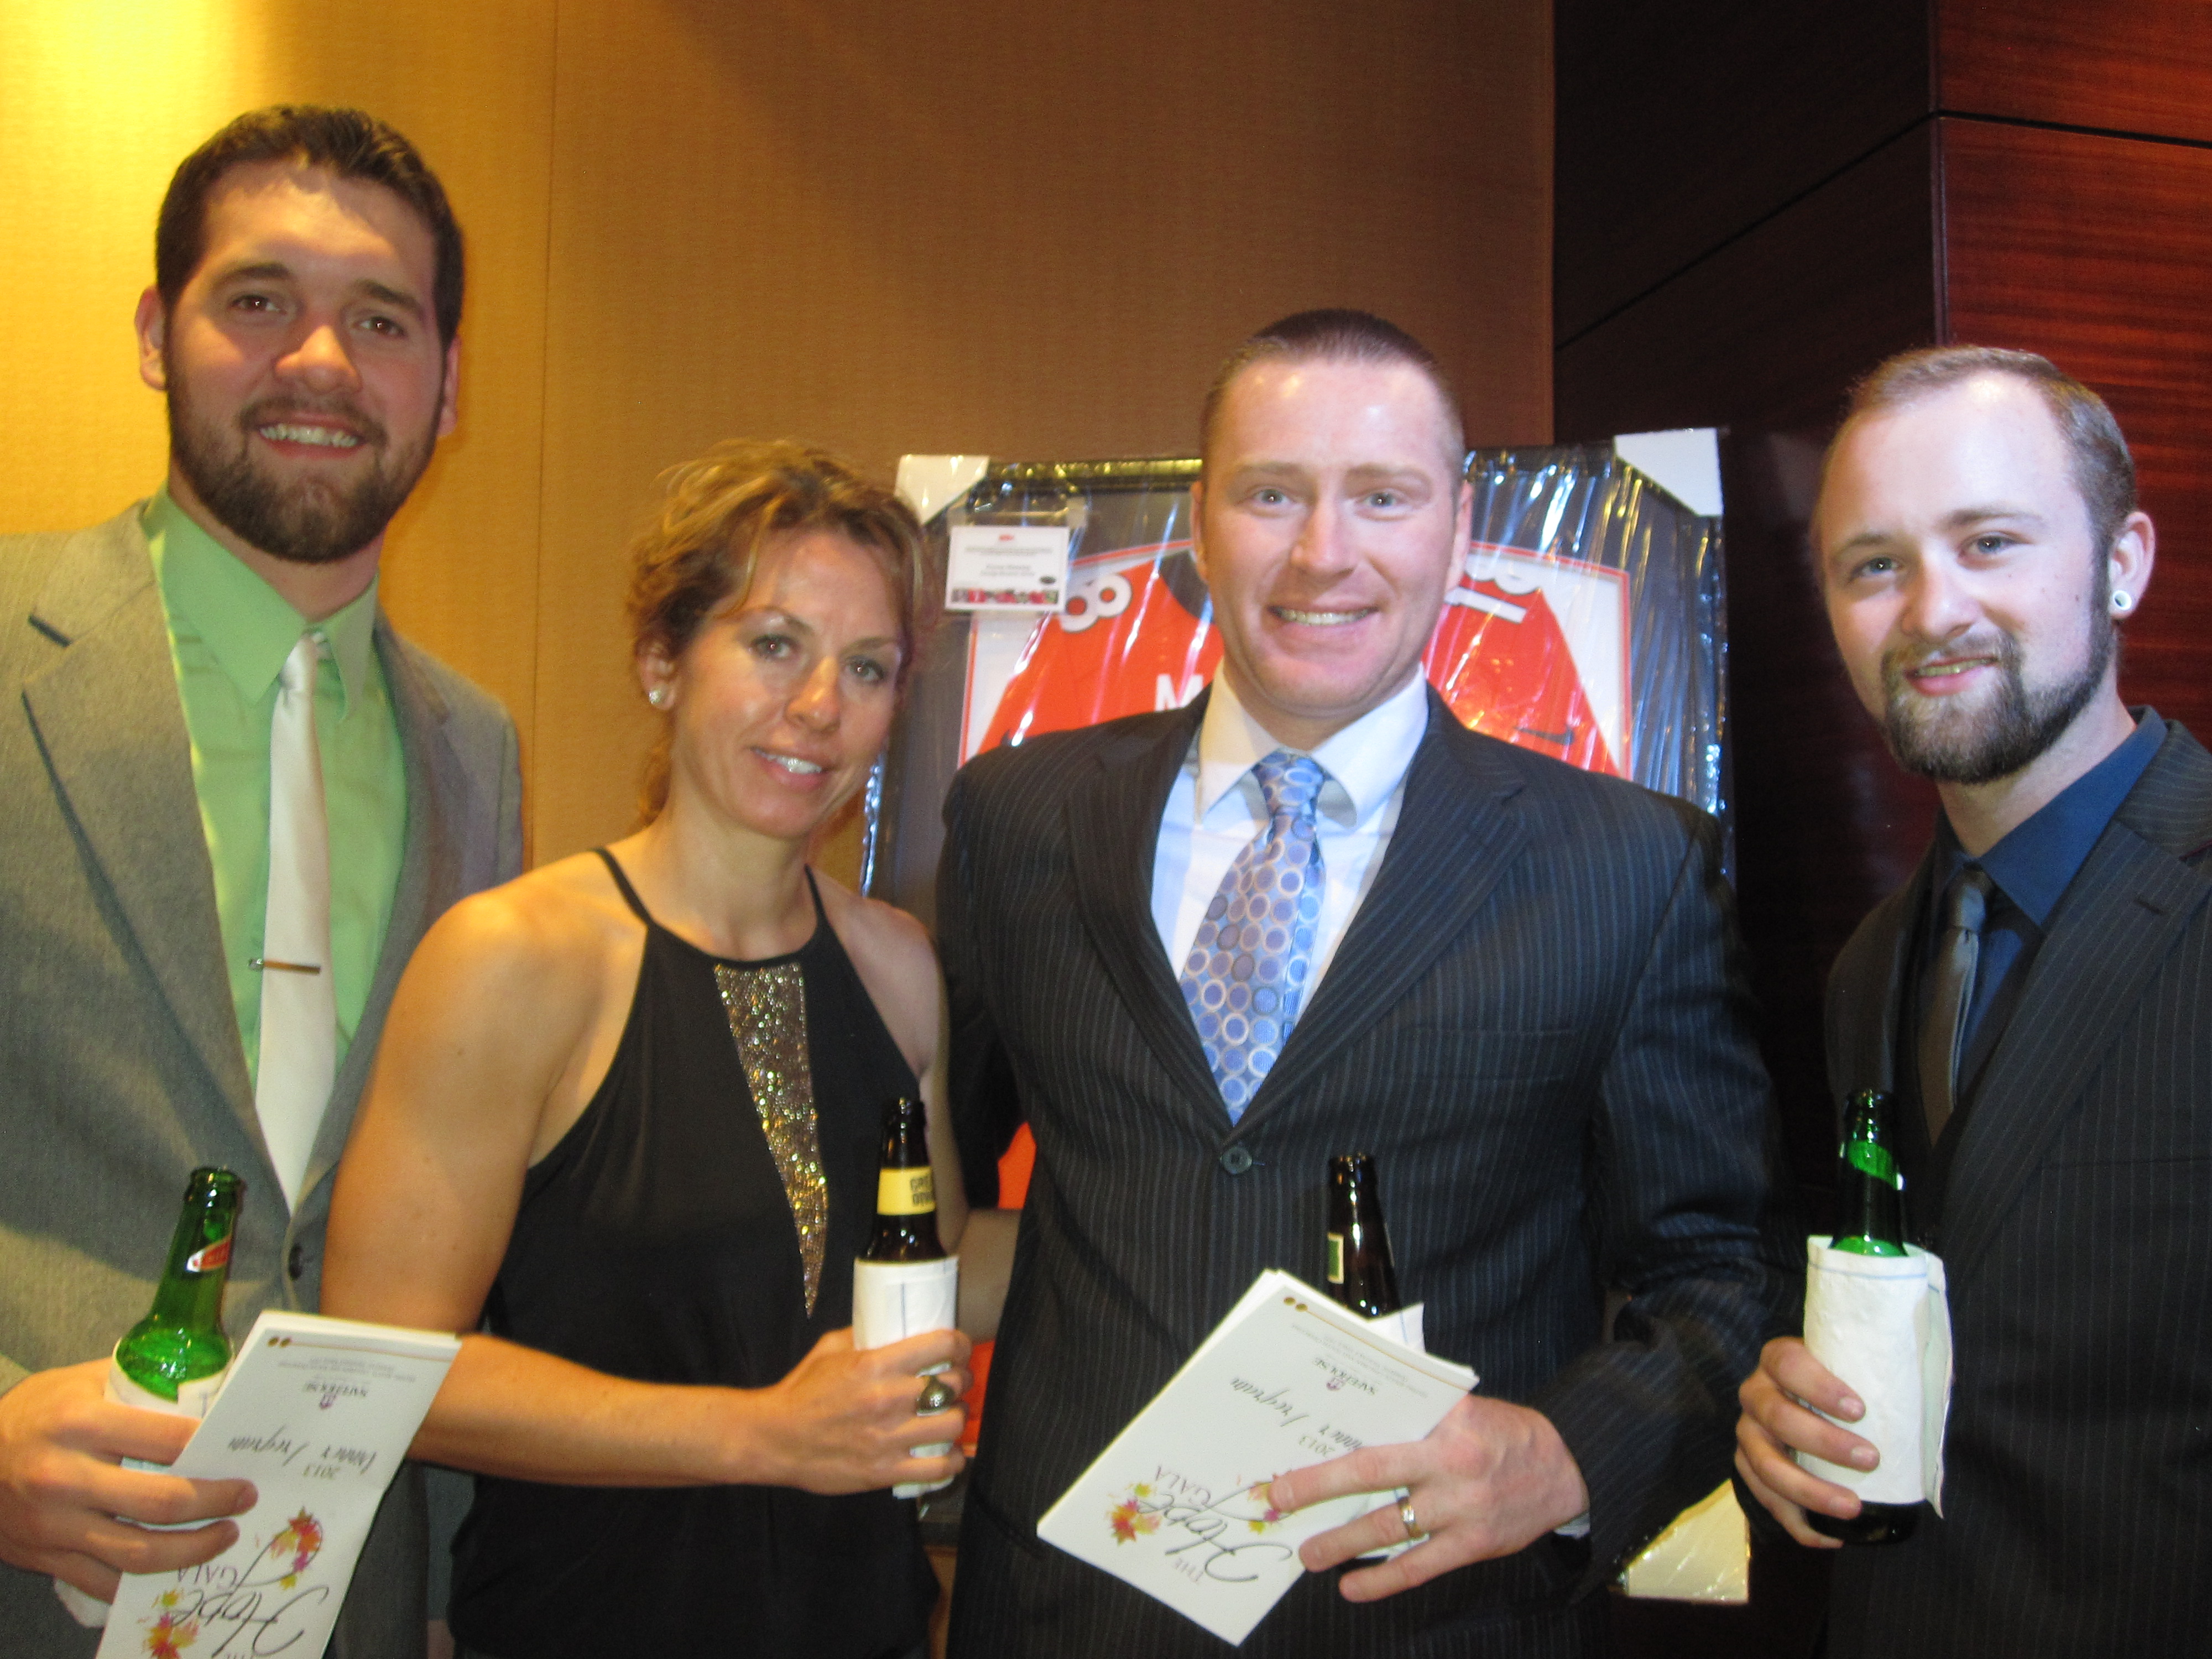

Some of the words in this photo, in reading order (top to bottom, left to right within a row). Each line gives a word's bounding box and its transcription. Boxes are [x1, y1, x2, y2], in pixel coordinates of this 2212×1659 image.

[1136, 1479, 1294, 1583] Hope
[1154, 1465, 1212, 1505] GALA
[168, 1516, 330, 1658] Hope
